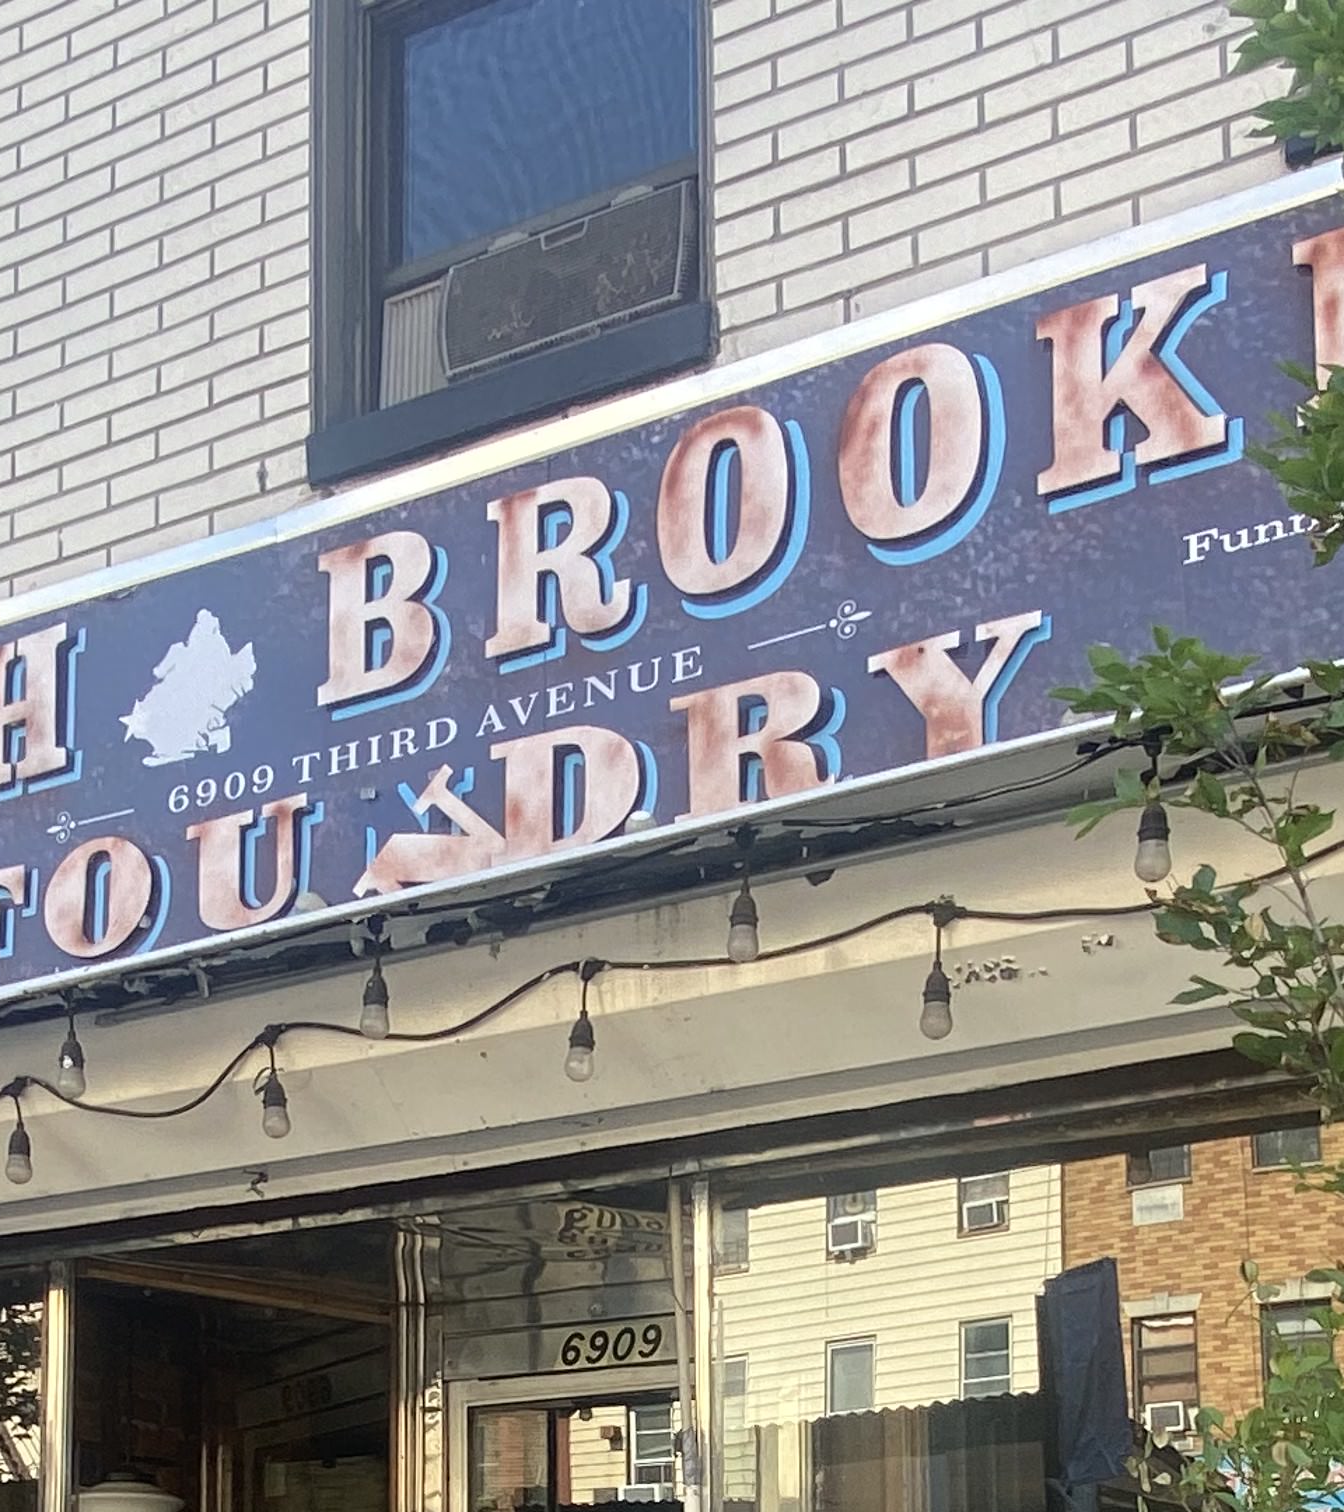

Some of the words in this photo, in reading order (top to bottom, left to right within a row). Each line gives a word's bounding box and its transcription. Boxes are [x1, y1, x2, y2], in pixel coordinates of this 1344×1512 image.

[168, 764, 274, 814] 6909
[292, 717, 457, 785] THIRD
[475, 646, 704, 737] AVENUE
[560, 1324, 663, 1366] 6909
